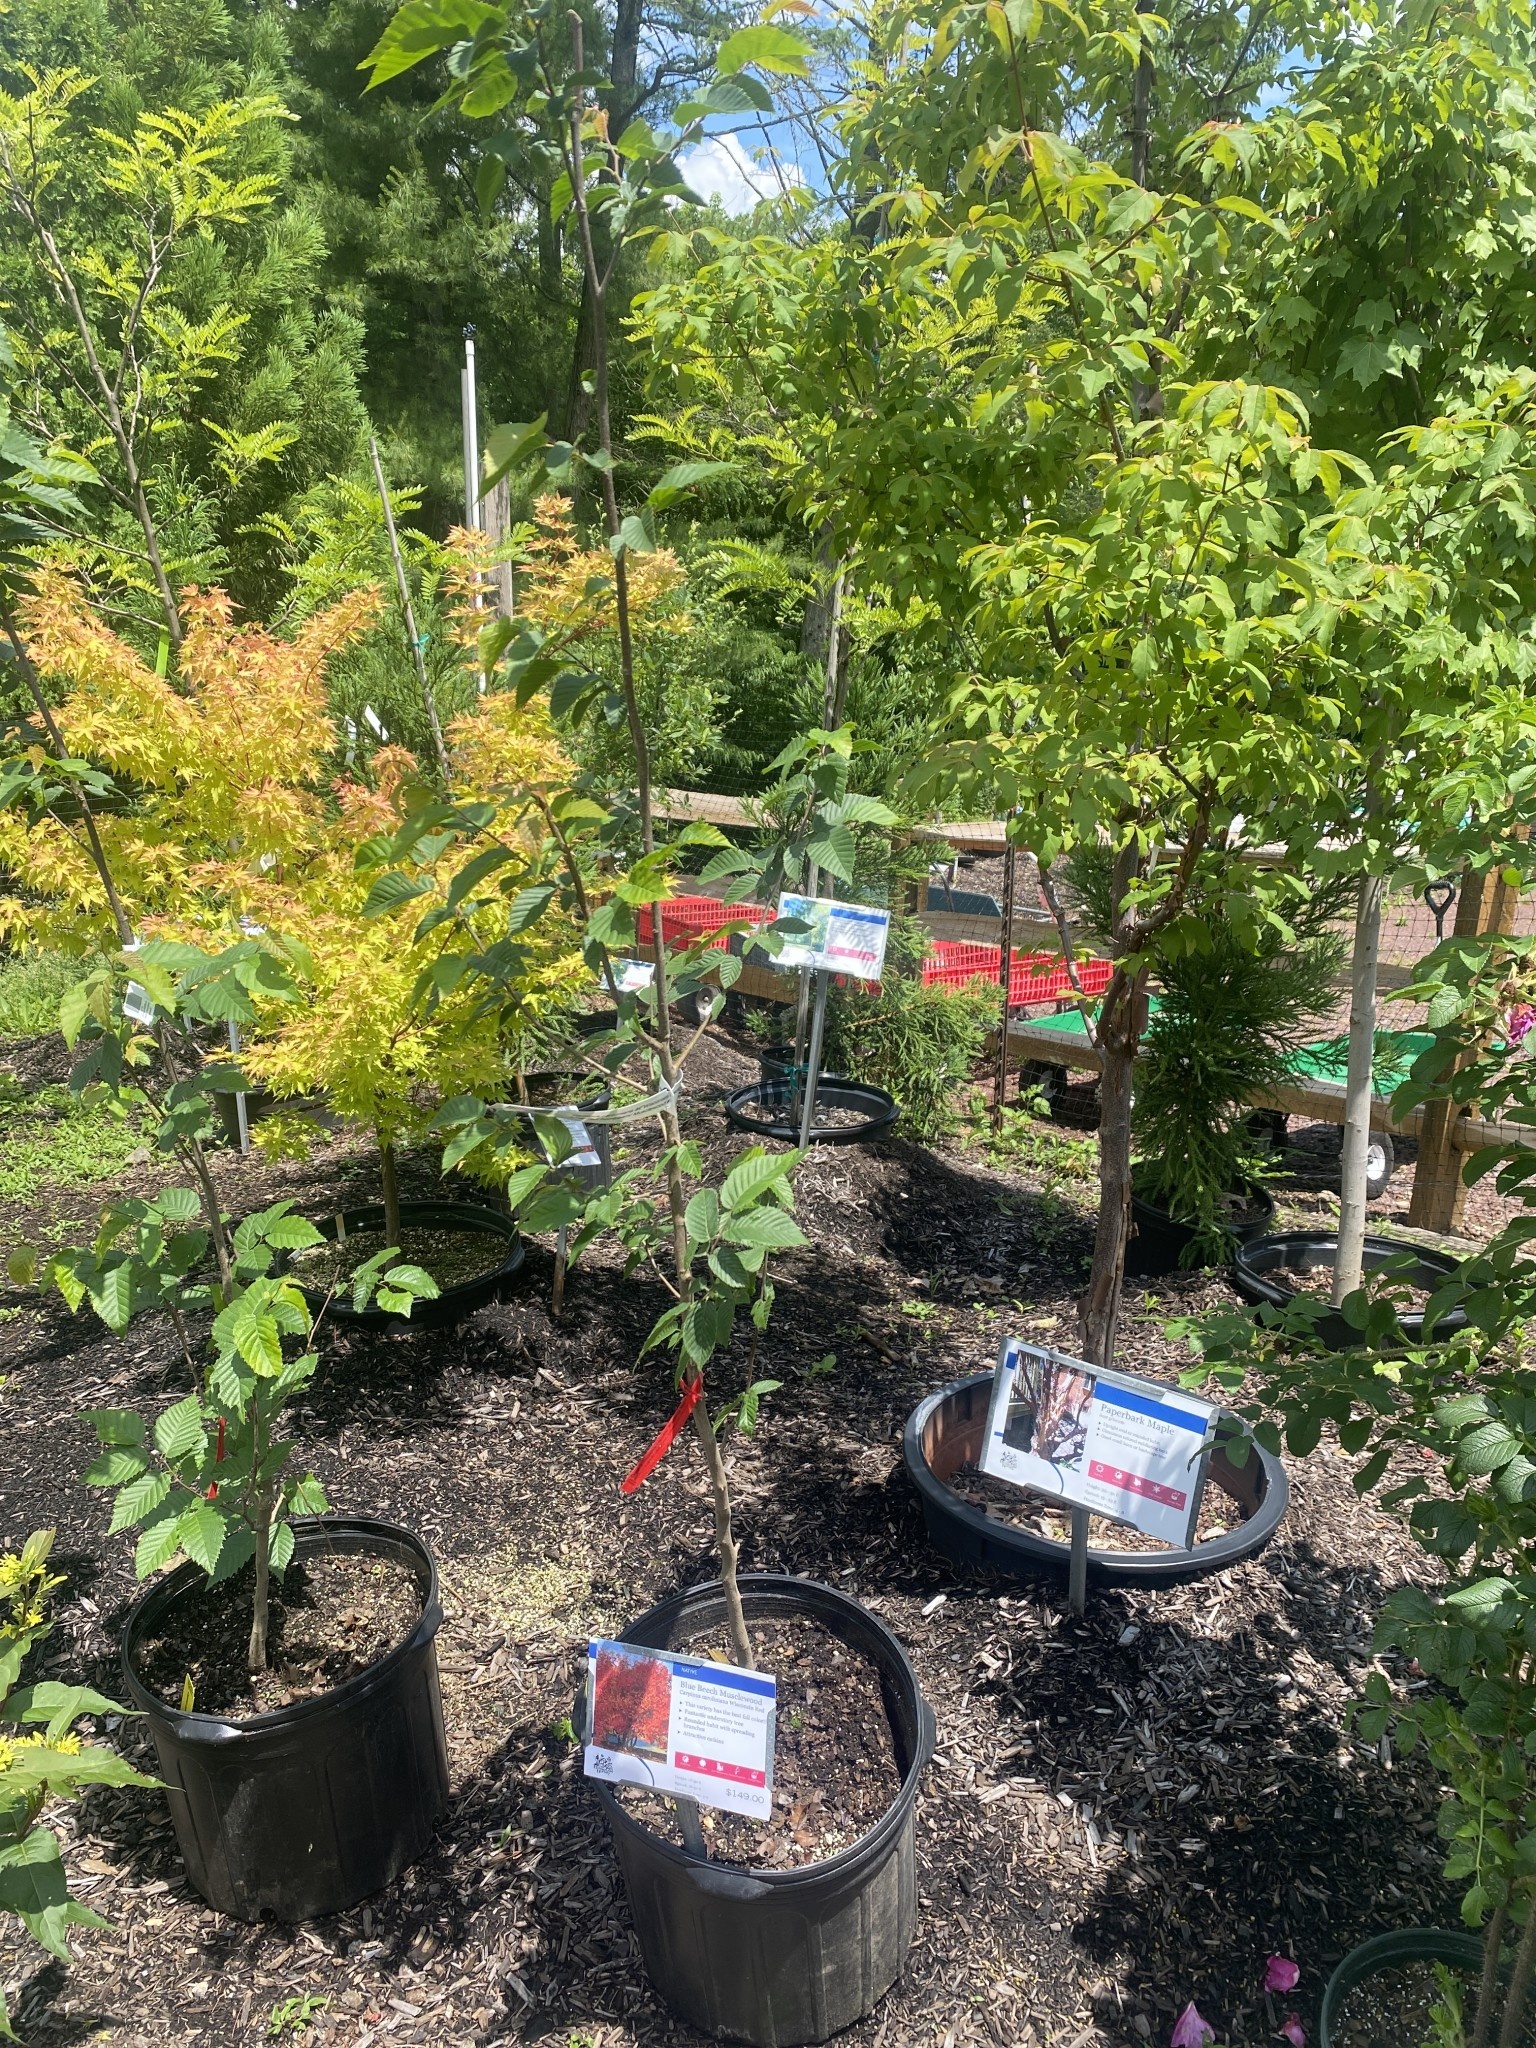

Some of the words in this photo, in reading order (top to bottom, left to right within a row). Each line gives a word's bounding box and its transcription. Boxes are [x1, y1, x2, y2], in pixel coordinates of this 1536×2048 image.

[1101, 1404, 1145, 1425] Paperbark
[1147, 1418, 1175, 1437] Maple
[681, 1667, 698, 1675] NATIVE
[679, 1689, 700, 1699] Carpinus
[680, 1680, 695, 1690] Blue
[697, 1684, 717, 1695] Beech
[719, 1689, 762, 1706] Musclewood
[726, 1788, 764, 1803] $149.00
